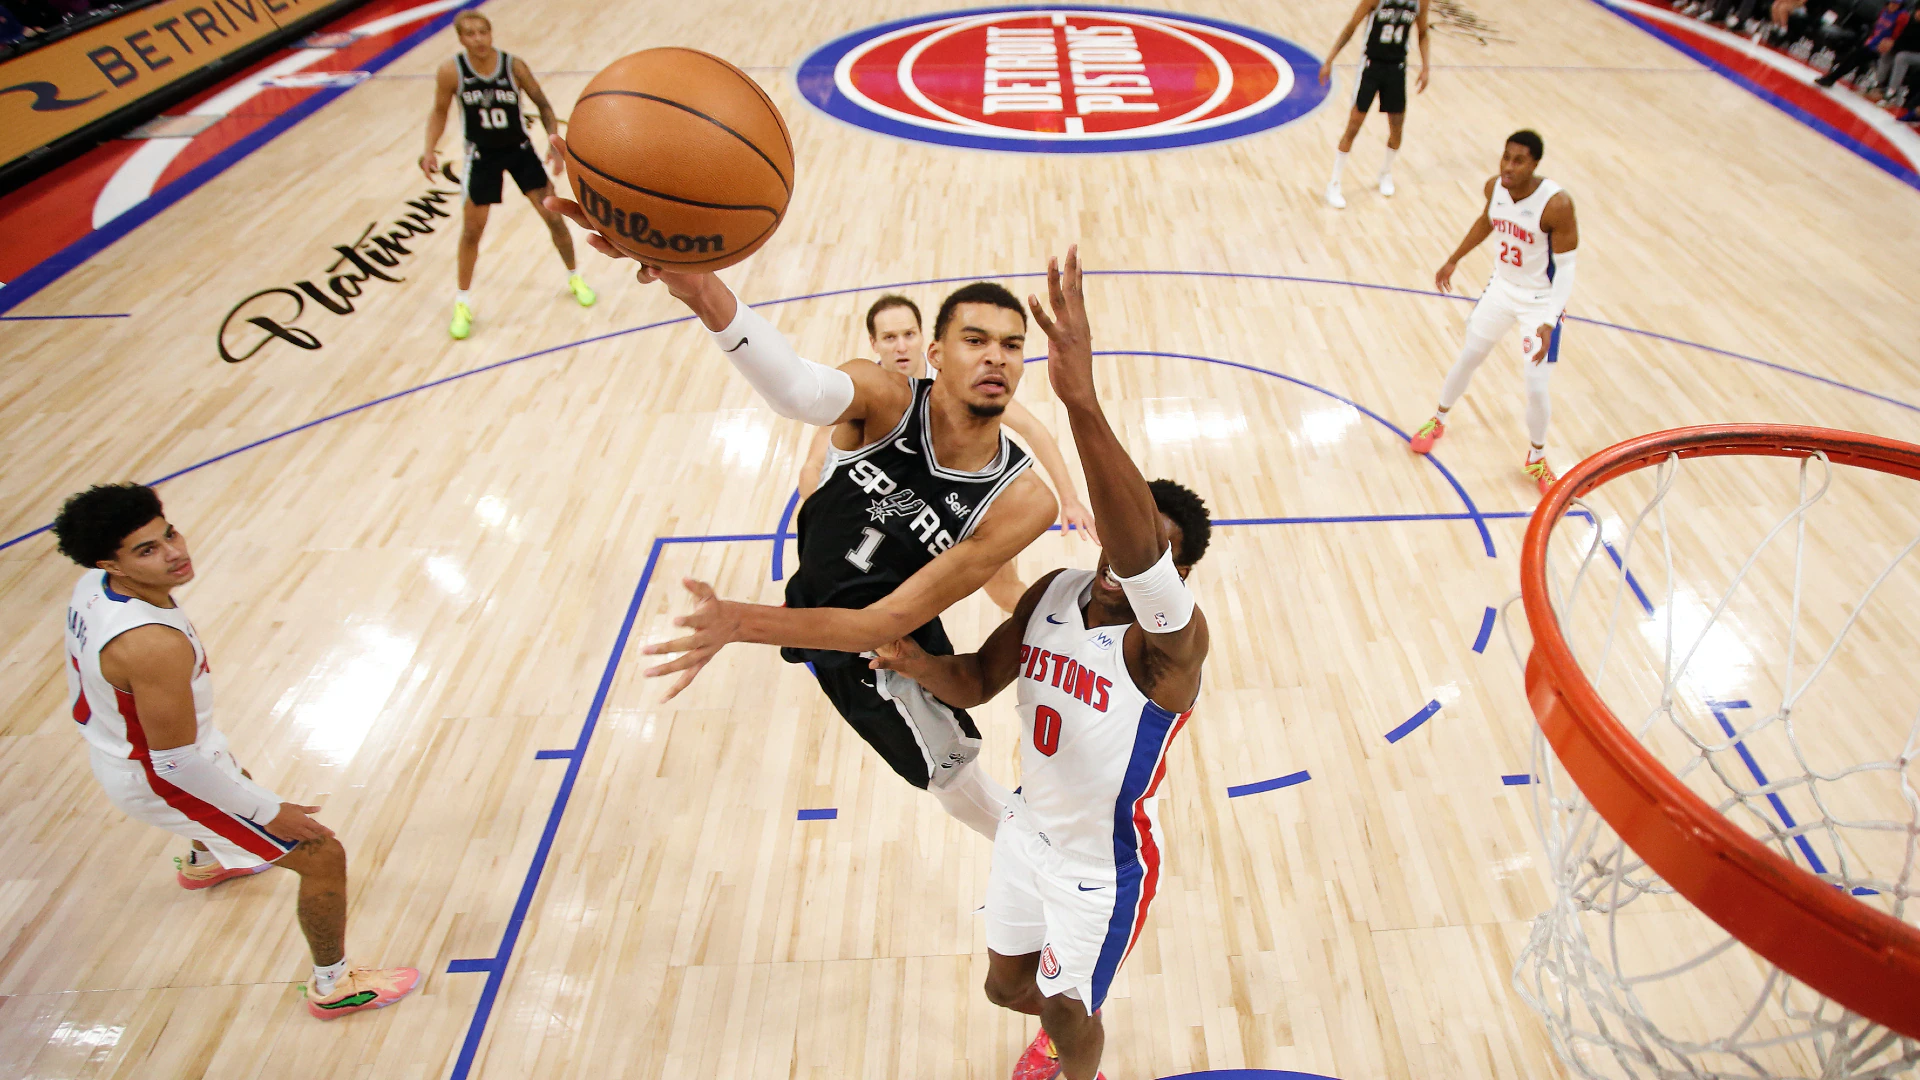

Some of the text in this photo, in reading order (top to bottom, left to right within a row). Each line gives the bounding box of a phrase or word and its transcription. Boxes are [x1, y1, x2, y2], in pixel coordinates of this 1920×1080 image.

[87, 0, 299, 88] BETRIV
[982, 26, 1064, 115] DETROIT
[1064, 25, 1160, 115] PISTONS
[479, 108, 509, 130] 10
[578, 174, 725, 253] Wilson
[1492, 217, 1535, 245] PISTONS
[218, 189, 460, 363] Platinum
[1500, 241, 1523, 268] 23
[845, 526, 886, 574] 1
[1020, 644, 1113, 713] PISTONS
[1033, 704, 1062, 757] 0
